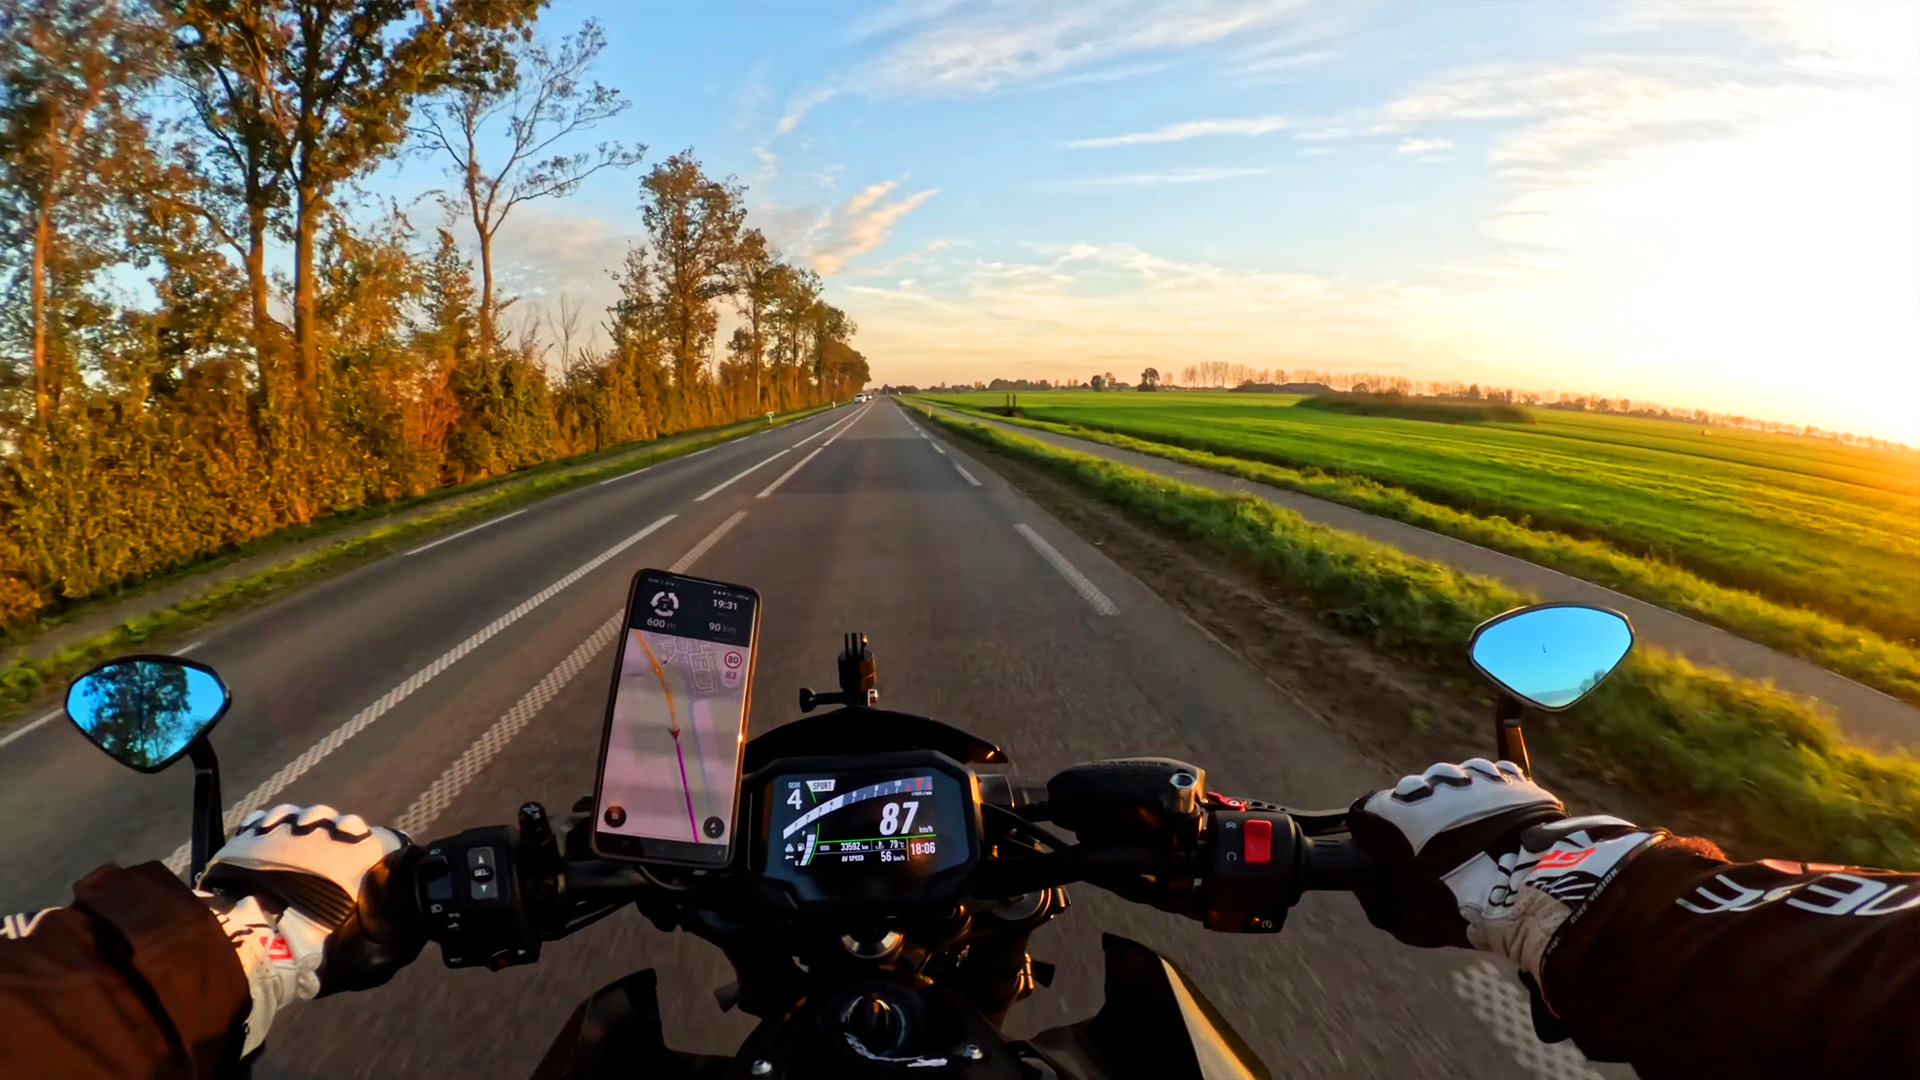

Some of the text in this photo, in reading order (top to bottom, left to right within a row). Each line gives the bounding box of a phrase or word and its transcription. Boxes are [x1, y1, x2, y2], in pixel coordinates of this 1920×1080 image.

[713, 599, 737, 610] 19:31
[647, 617, 665, 628] 600
[709, 622, 736, 634] 90 km
[728, 656, 739, 664] 80
[725, 671, 737, 679] 83
[813, 781, 832, 790] SPORT
[786, 788, 802, 810] 4
[879, 801, 919, 836] 87
[889, 840, 898, 848] 79
[910, 841, 936, 855] 18:06
[881, 850, 892, 862] 56
